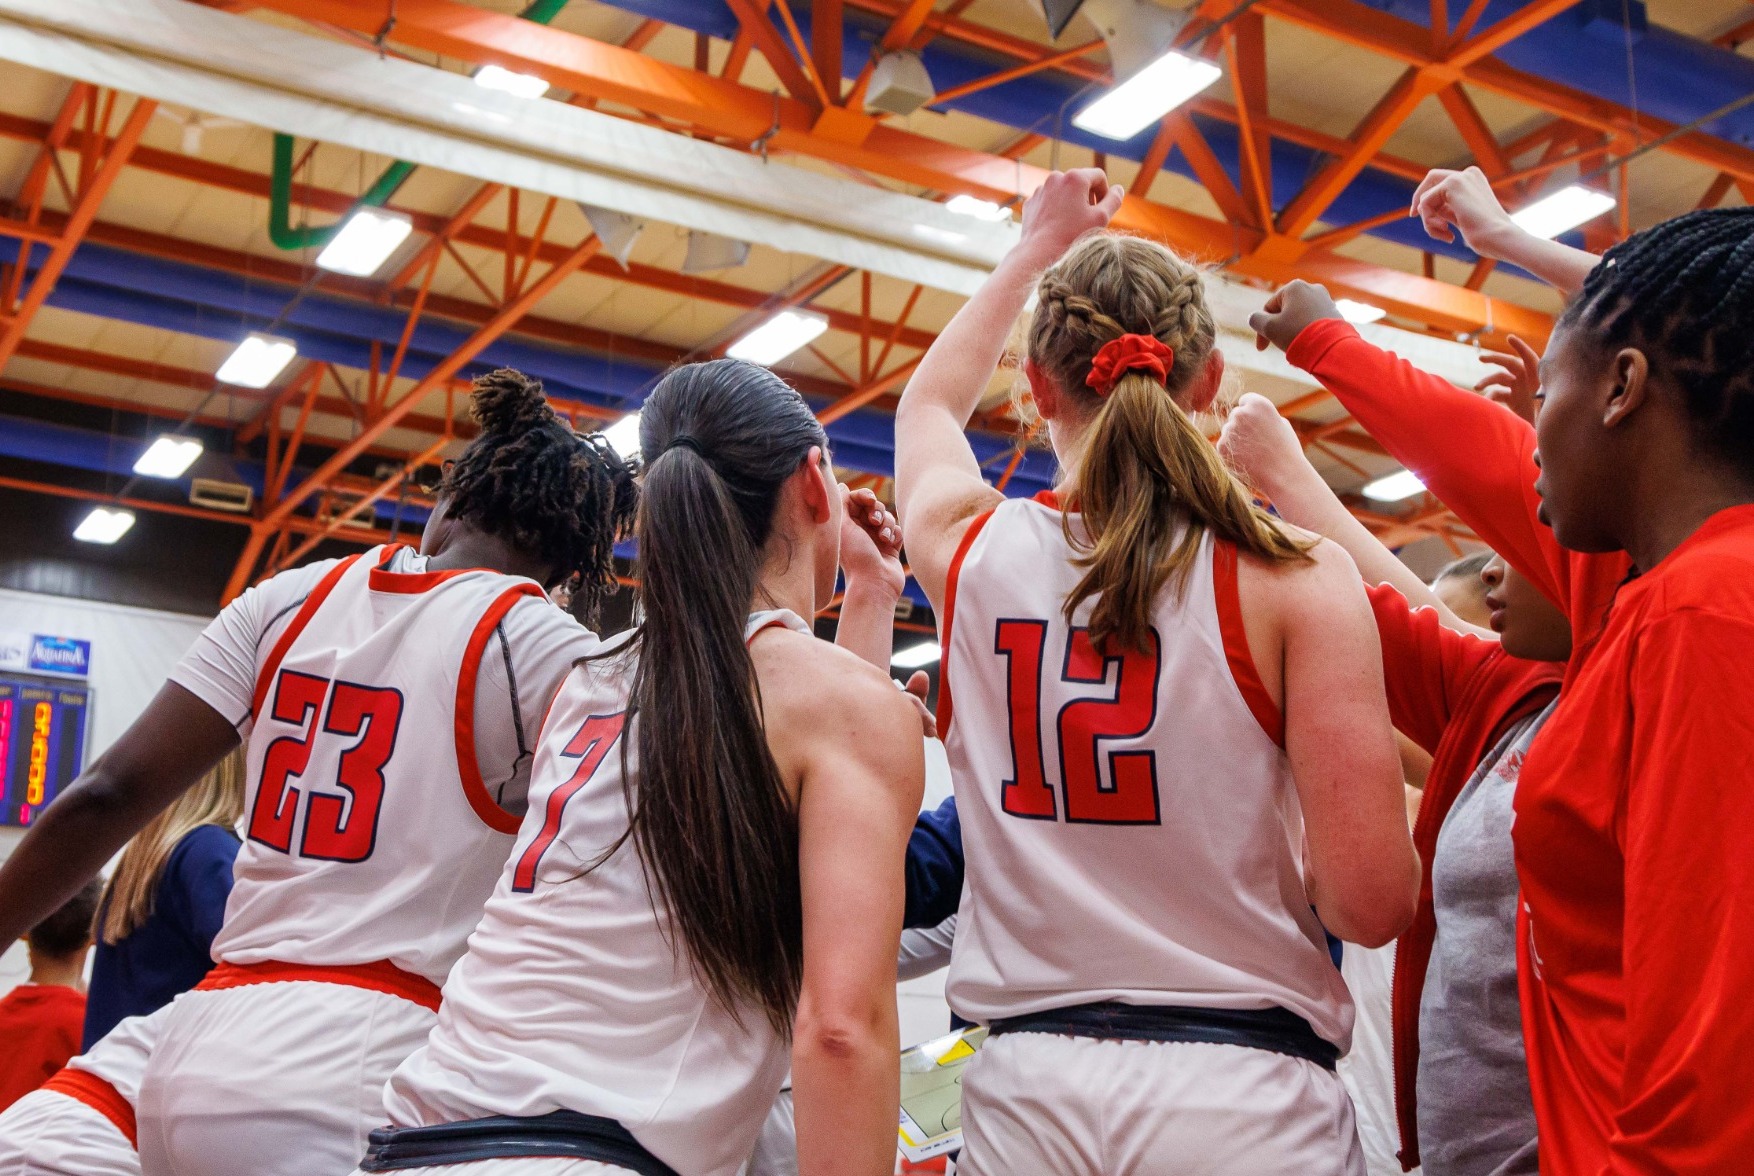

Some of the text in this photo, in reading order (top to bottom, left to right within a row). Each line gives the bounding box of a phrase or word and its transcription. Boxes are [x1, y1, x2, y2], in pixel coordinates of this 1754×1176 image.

[248, 669, 404, 863] 23
[512, 710, 636, 893] 7
[994, 618, 1162, 825] 12
